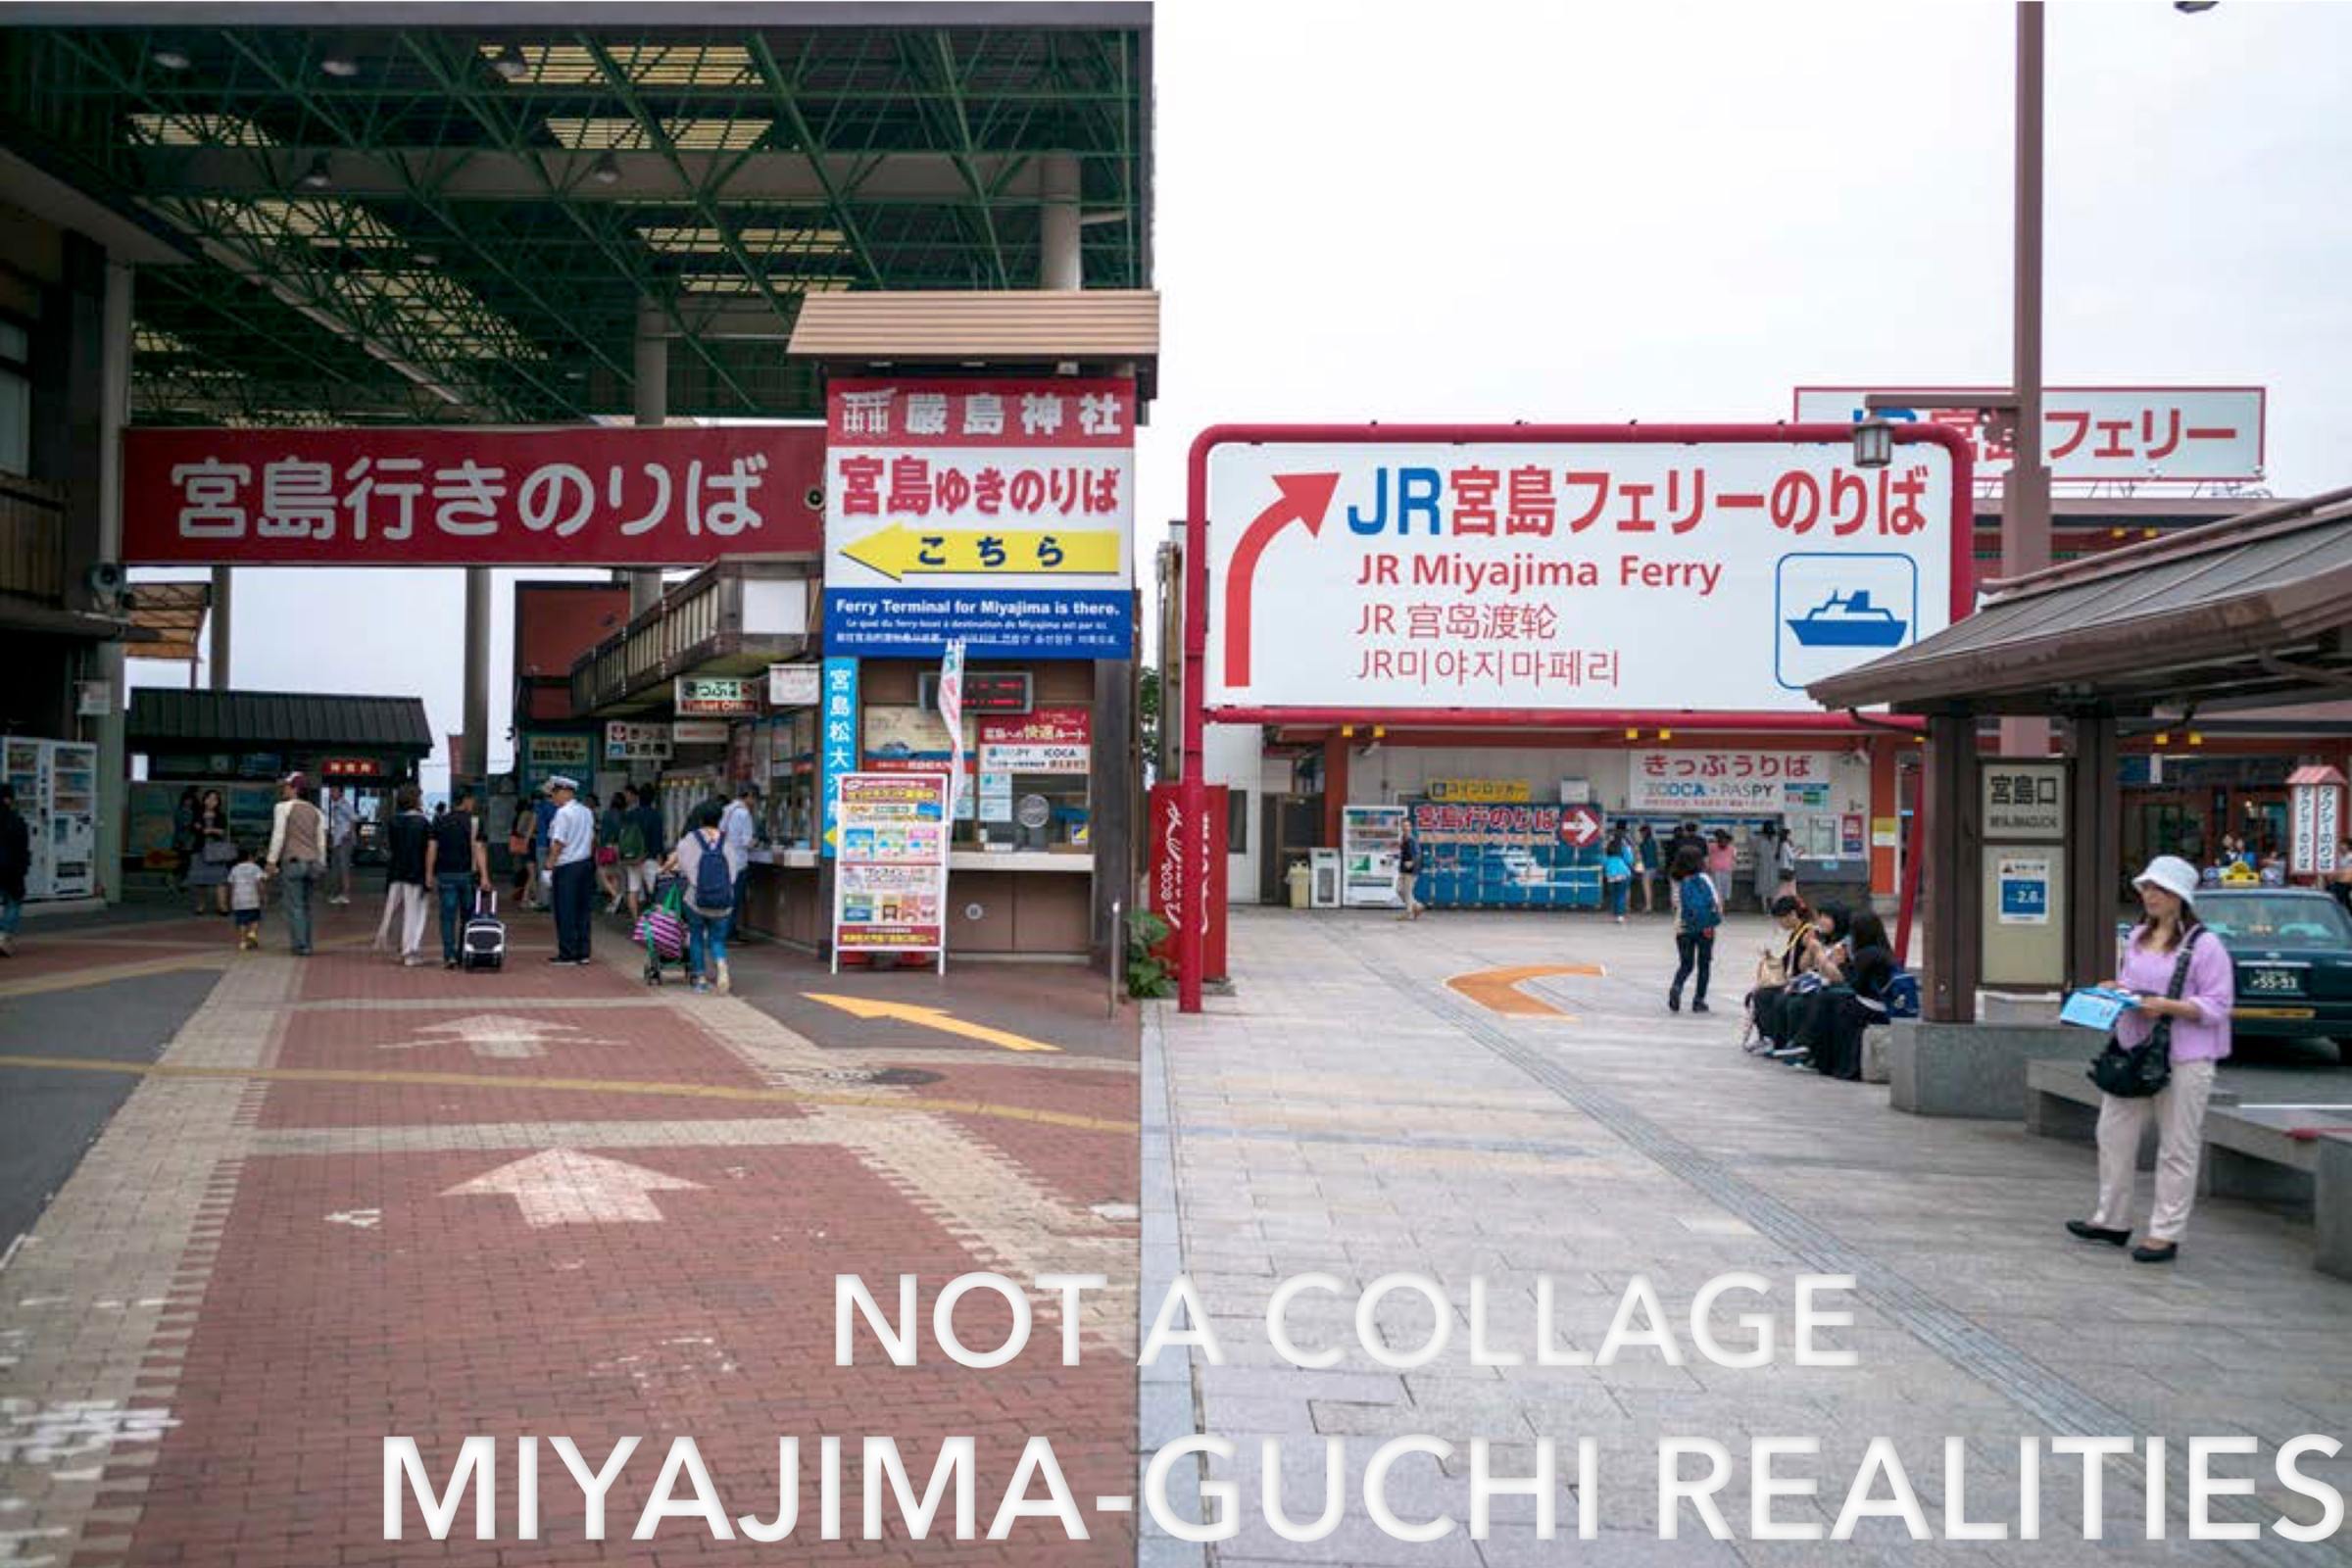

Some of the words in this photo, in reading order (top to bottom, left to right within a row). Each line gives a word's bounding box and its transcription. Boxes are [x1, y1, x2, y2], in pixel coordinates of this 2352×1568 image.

[171, 455, 770, 541] 宮島行きのりば
[839, 455, 1120, 516] 宮島ゆきのりば
[918, 536, 1064, 567] こちら
[1357, 554, 1400, 588] JR
[1413, 553, 1599, 596] Miyajima
[1620, 555, 1722, 596] Ferry
[837, 599, 877, 615] Ferry
[883, 599, 951, 613] Terminal
[981, 600, 1051, 616] Miyajima
[1054, 601, 1068, 613] is
[1357, 604, 1394, 636] JR
[1644, 754, 1813, 777] きっぷうりば
[1990, 773, 2057, 804] 宮島口
